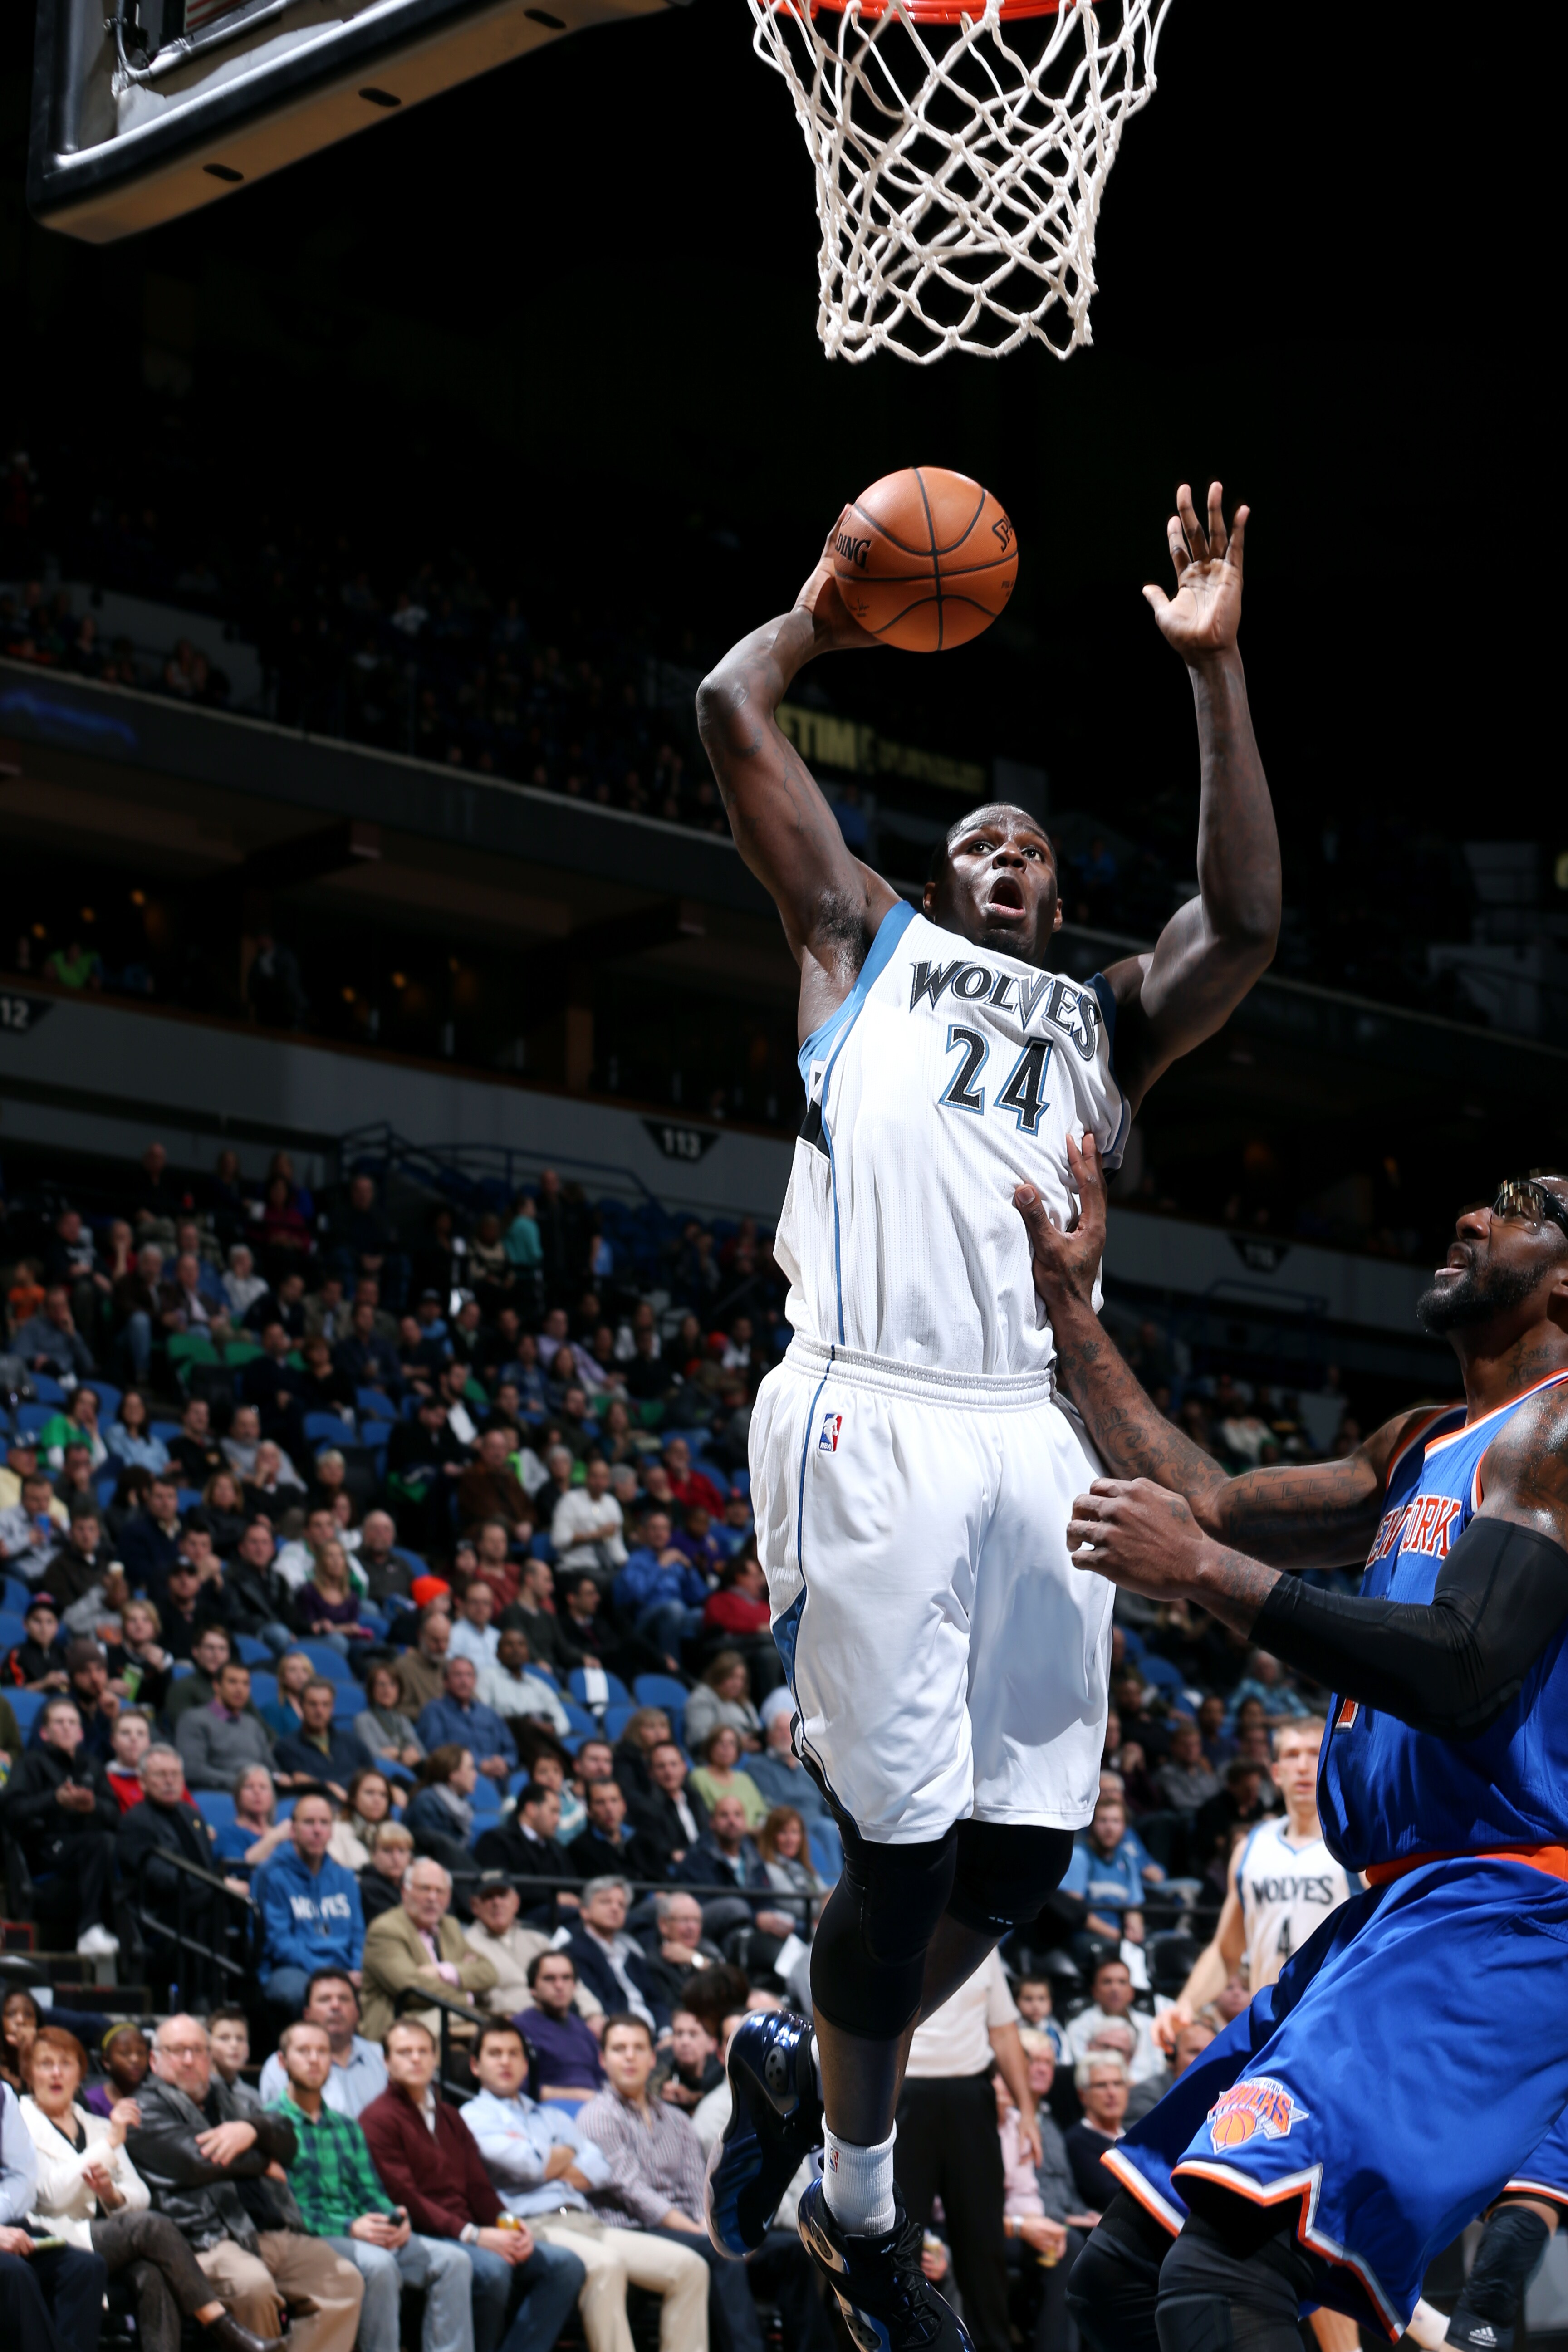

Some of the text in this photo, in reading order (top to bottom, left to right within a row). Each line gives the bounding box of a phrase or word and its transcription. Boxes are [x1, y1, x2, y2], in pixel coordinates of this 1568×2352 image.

[909, 960, 1102, 1061] WOLVES
[937, 1024, 1054, 1137] 24
[820, 1442, 832, 1450] NBA
[1252, 1875, 1333, 1906] WOLVES
